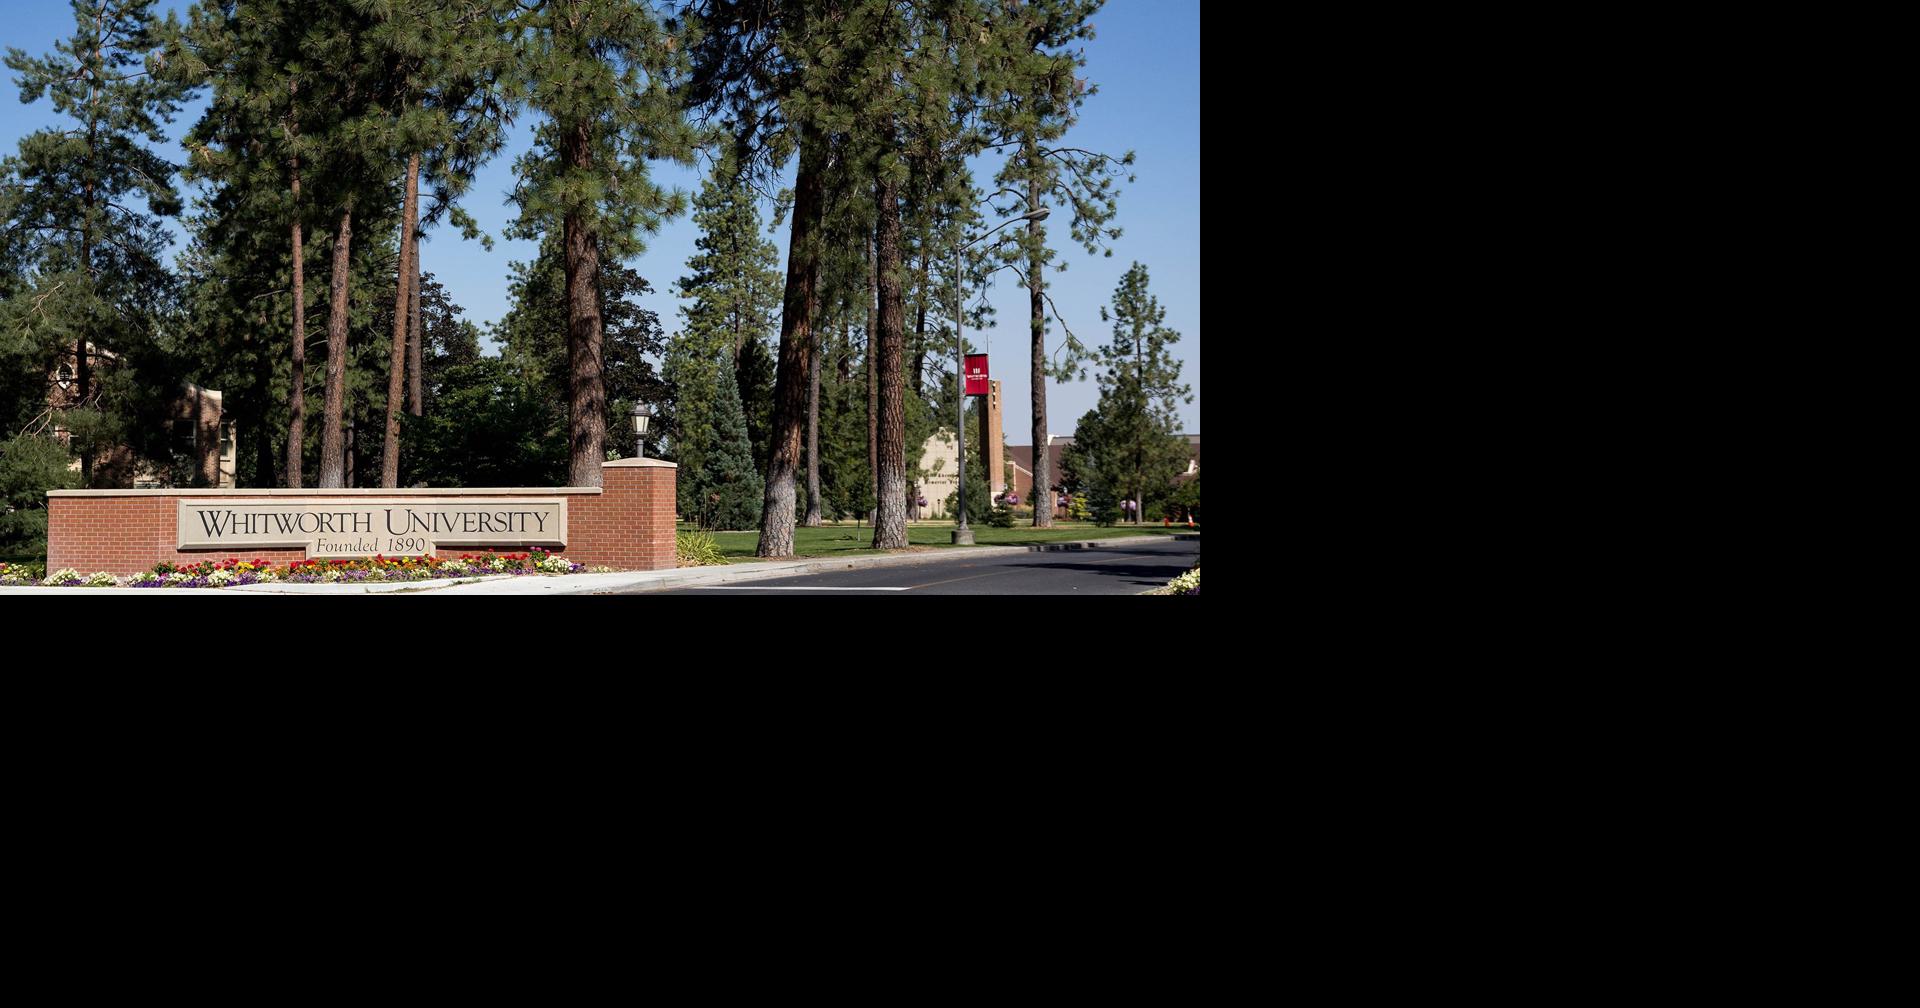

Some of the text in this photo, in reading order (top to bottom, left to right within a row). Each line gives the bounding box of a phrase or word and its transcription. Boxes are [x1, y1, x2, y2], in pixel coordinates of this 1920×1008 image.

[197, 508, 550, 538] WHITWORTH UNIVERSITY
[316, 537, 425, 553] Founded 1890
